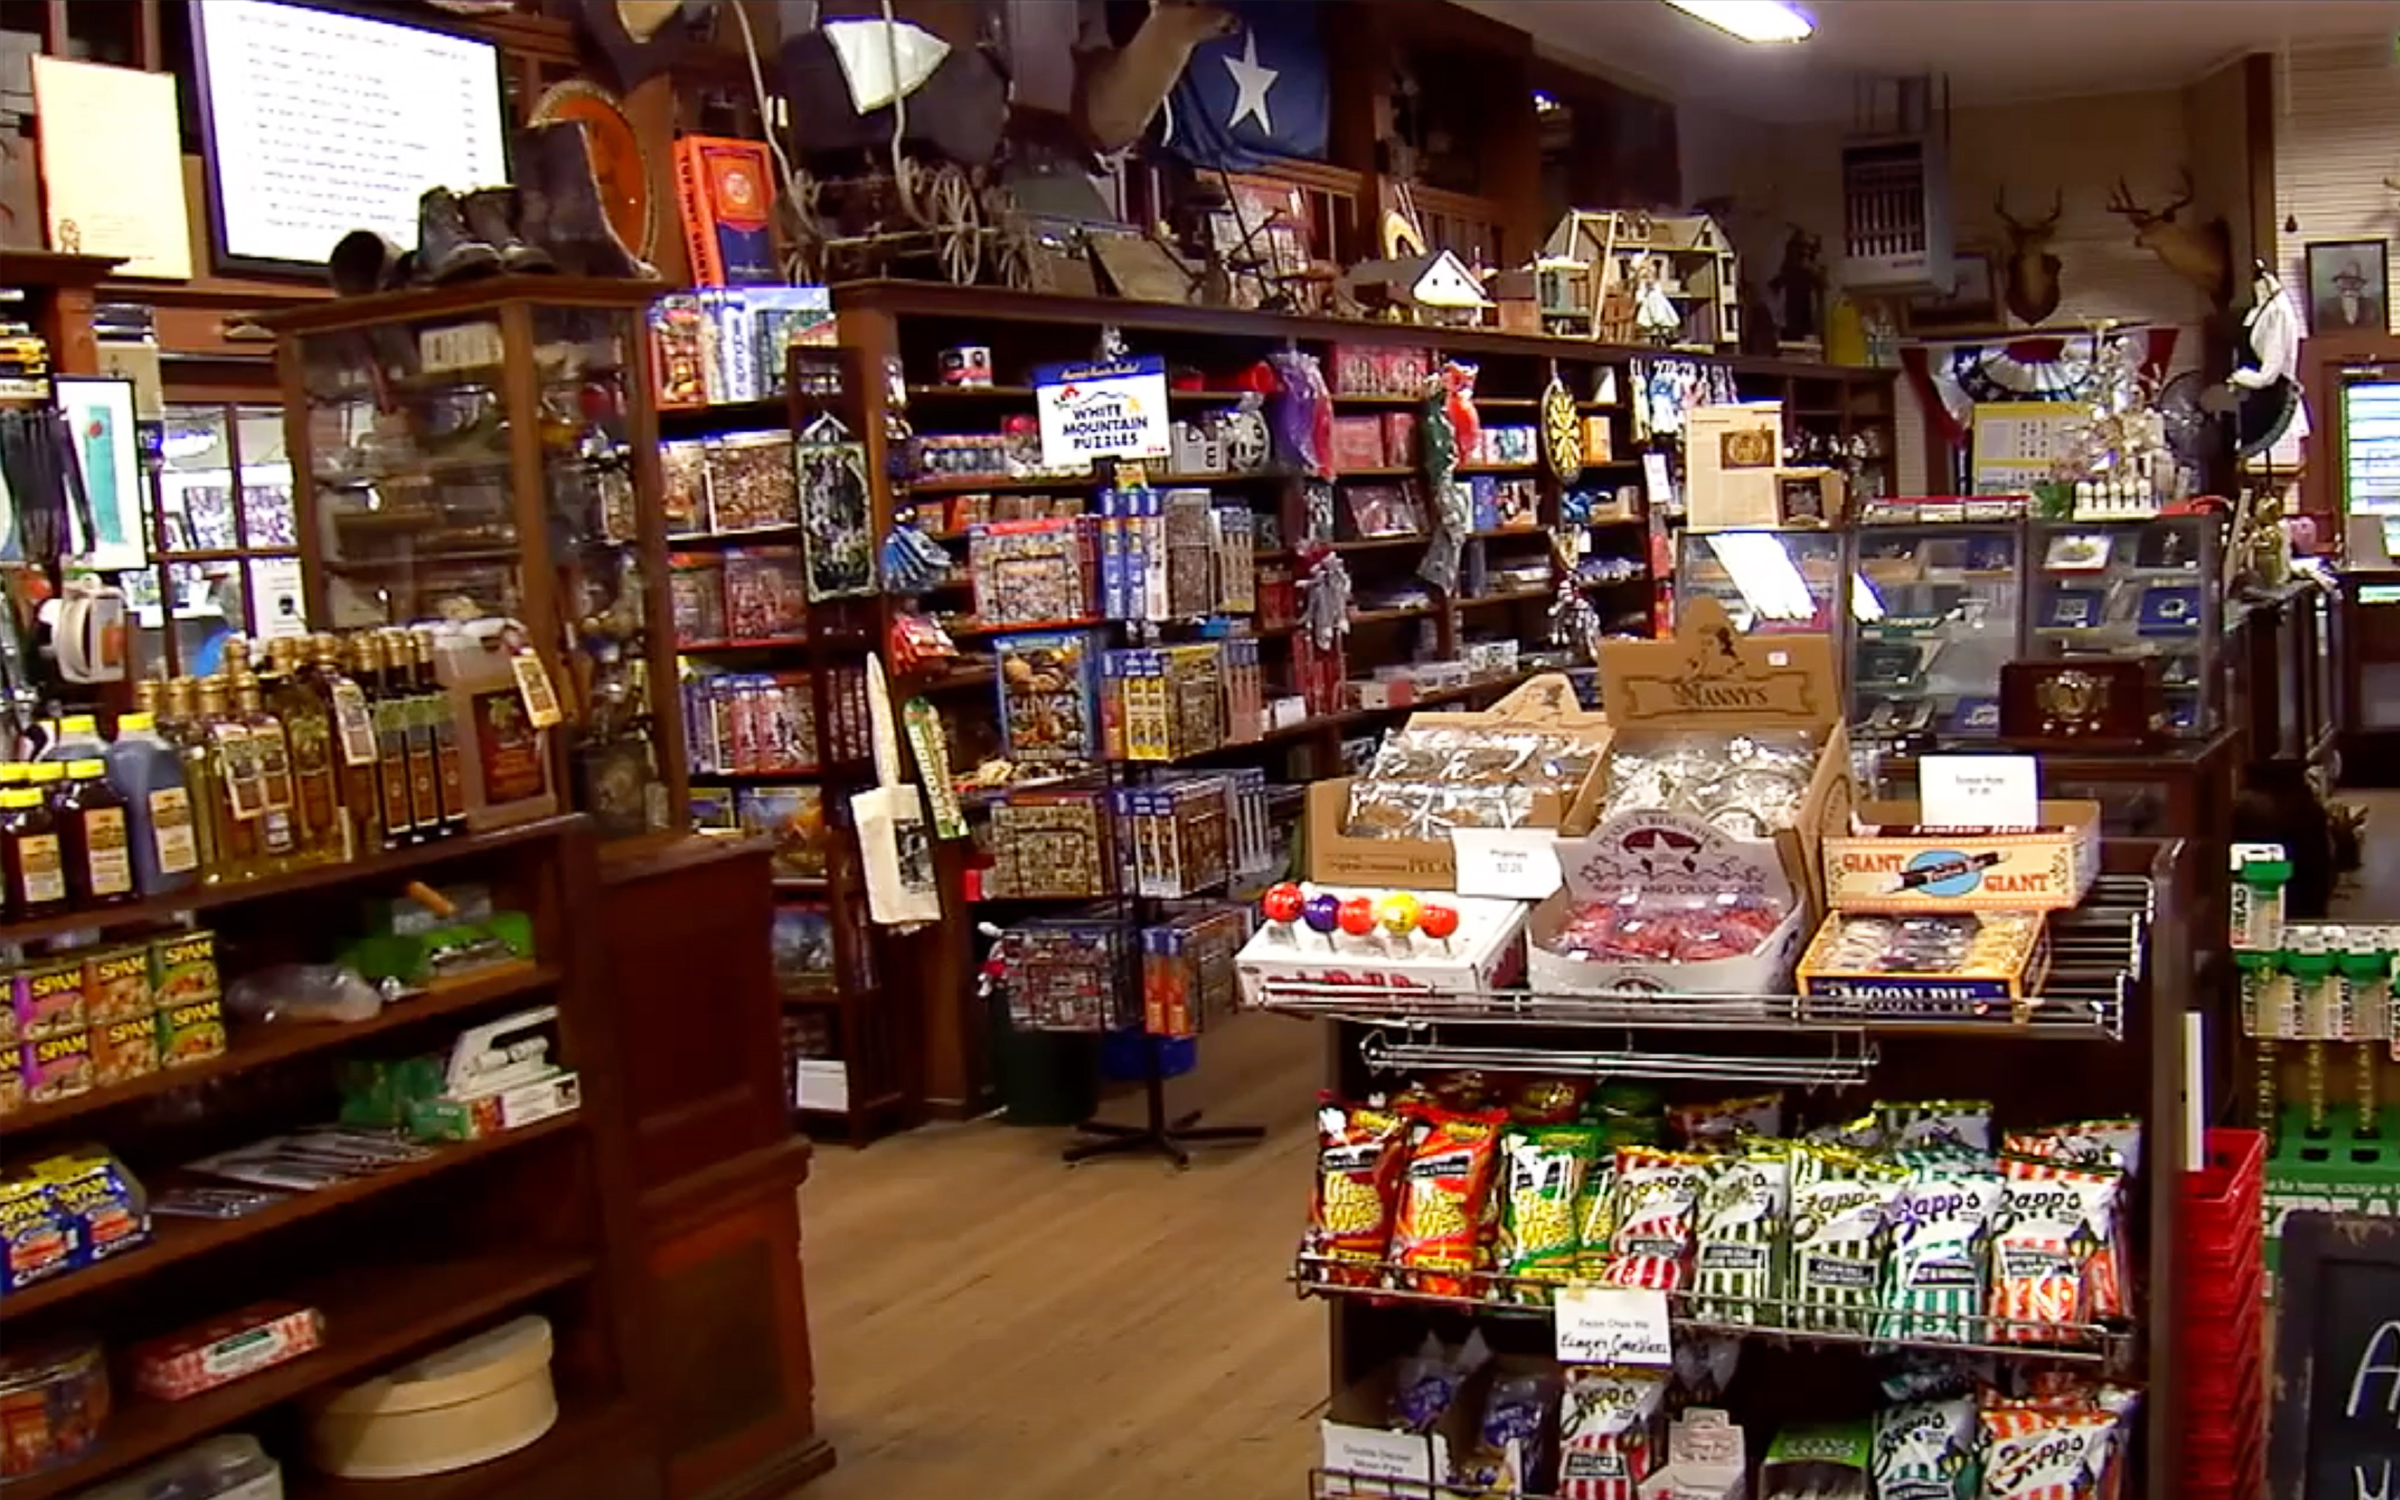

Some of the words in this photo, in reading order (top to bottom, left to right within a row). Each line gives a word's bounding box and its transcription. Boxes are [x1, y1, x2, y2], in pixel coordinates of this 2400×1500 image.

[1073, 404, 1121, 420] WHITE
[1063, 417, 1148, 436] MOUNTAIN
[1074, 432, 1138, 449] PUZZLES
[1841, 853, 1904, 873] GIANT
[1983, 873, 2050, 892] GIANT
[165, 940, 214, 963] SPAM
[99, 956, 147, 978] SPAM
[32, 970, 82, 997] SPAM
[1840, 986, 1925, 1011] MOON
[1930, 986, 1977, 1011] PIE
[172, 1001, 221, 1026] SPAM
[108, 1018, 157, 1044] SPAM
[38, 1033, 89, 1063] SPAM
